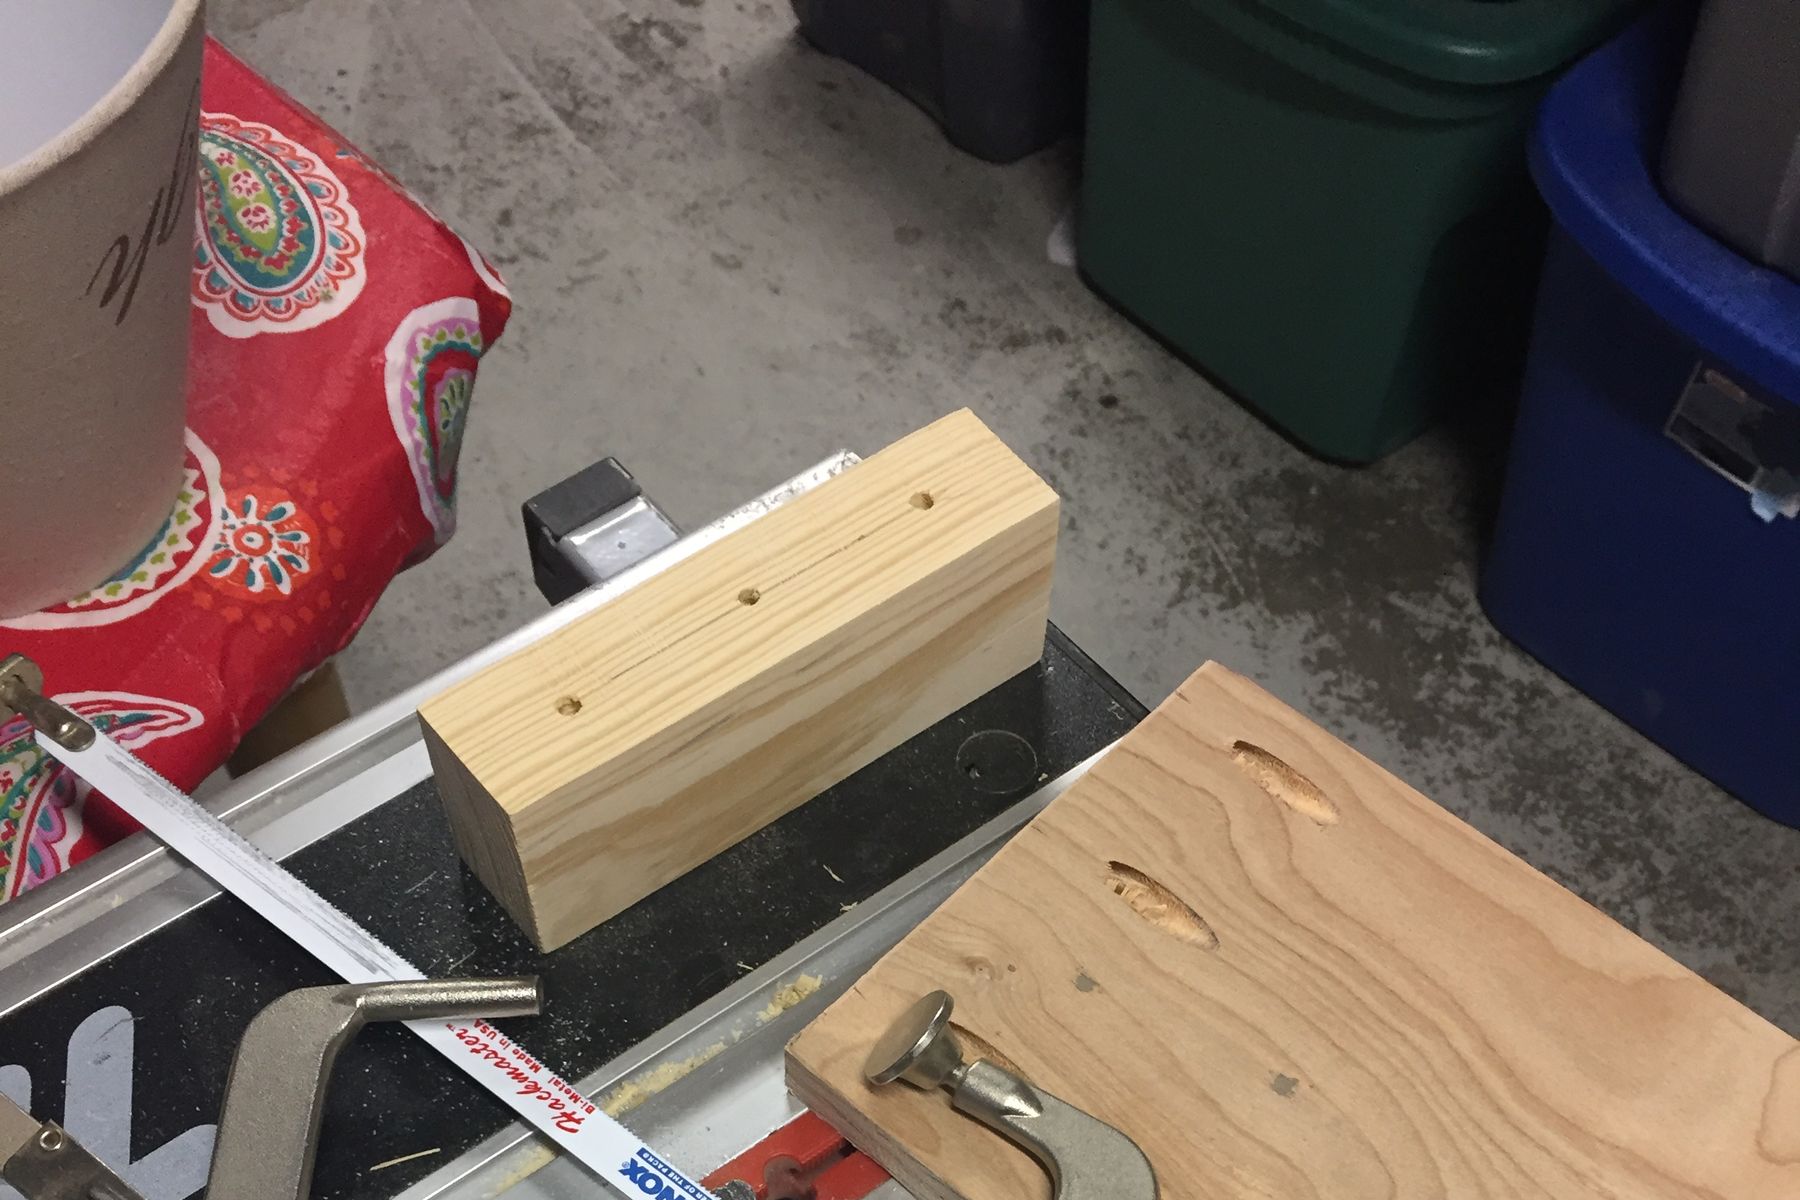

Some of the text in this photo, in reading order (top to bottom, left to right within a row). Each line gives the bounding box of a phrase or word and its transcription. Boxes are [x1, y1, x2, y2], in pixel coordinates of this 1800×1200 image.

[456, 1028, 585, 1133] Hackmaster
[473, 1018, 596, 1115] Bi-Metal Made in USA
[668, 1171, 684, 1187] THE
[684, 1184, 696, 1195] OF
